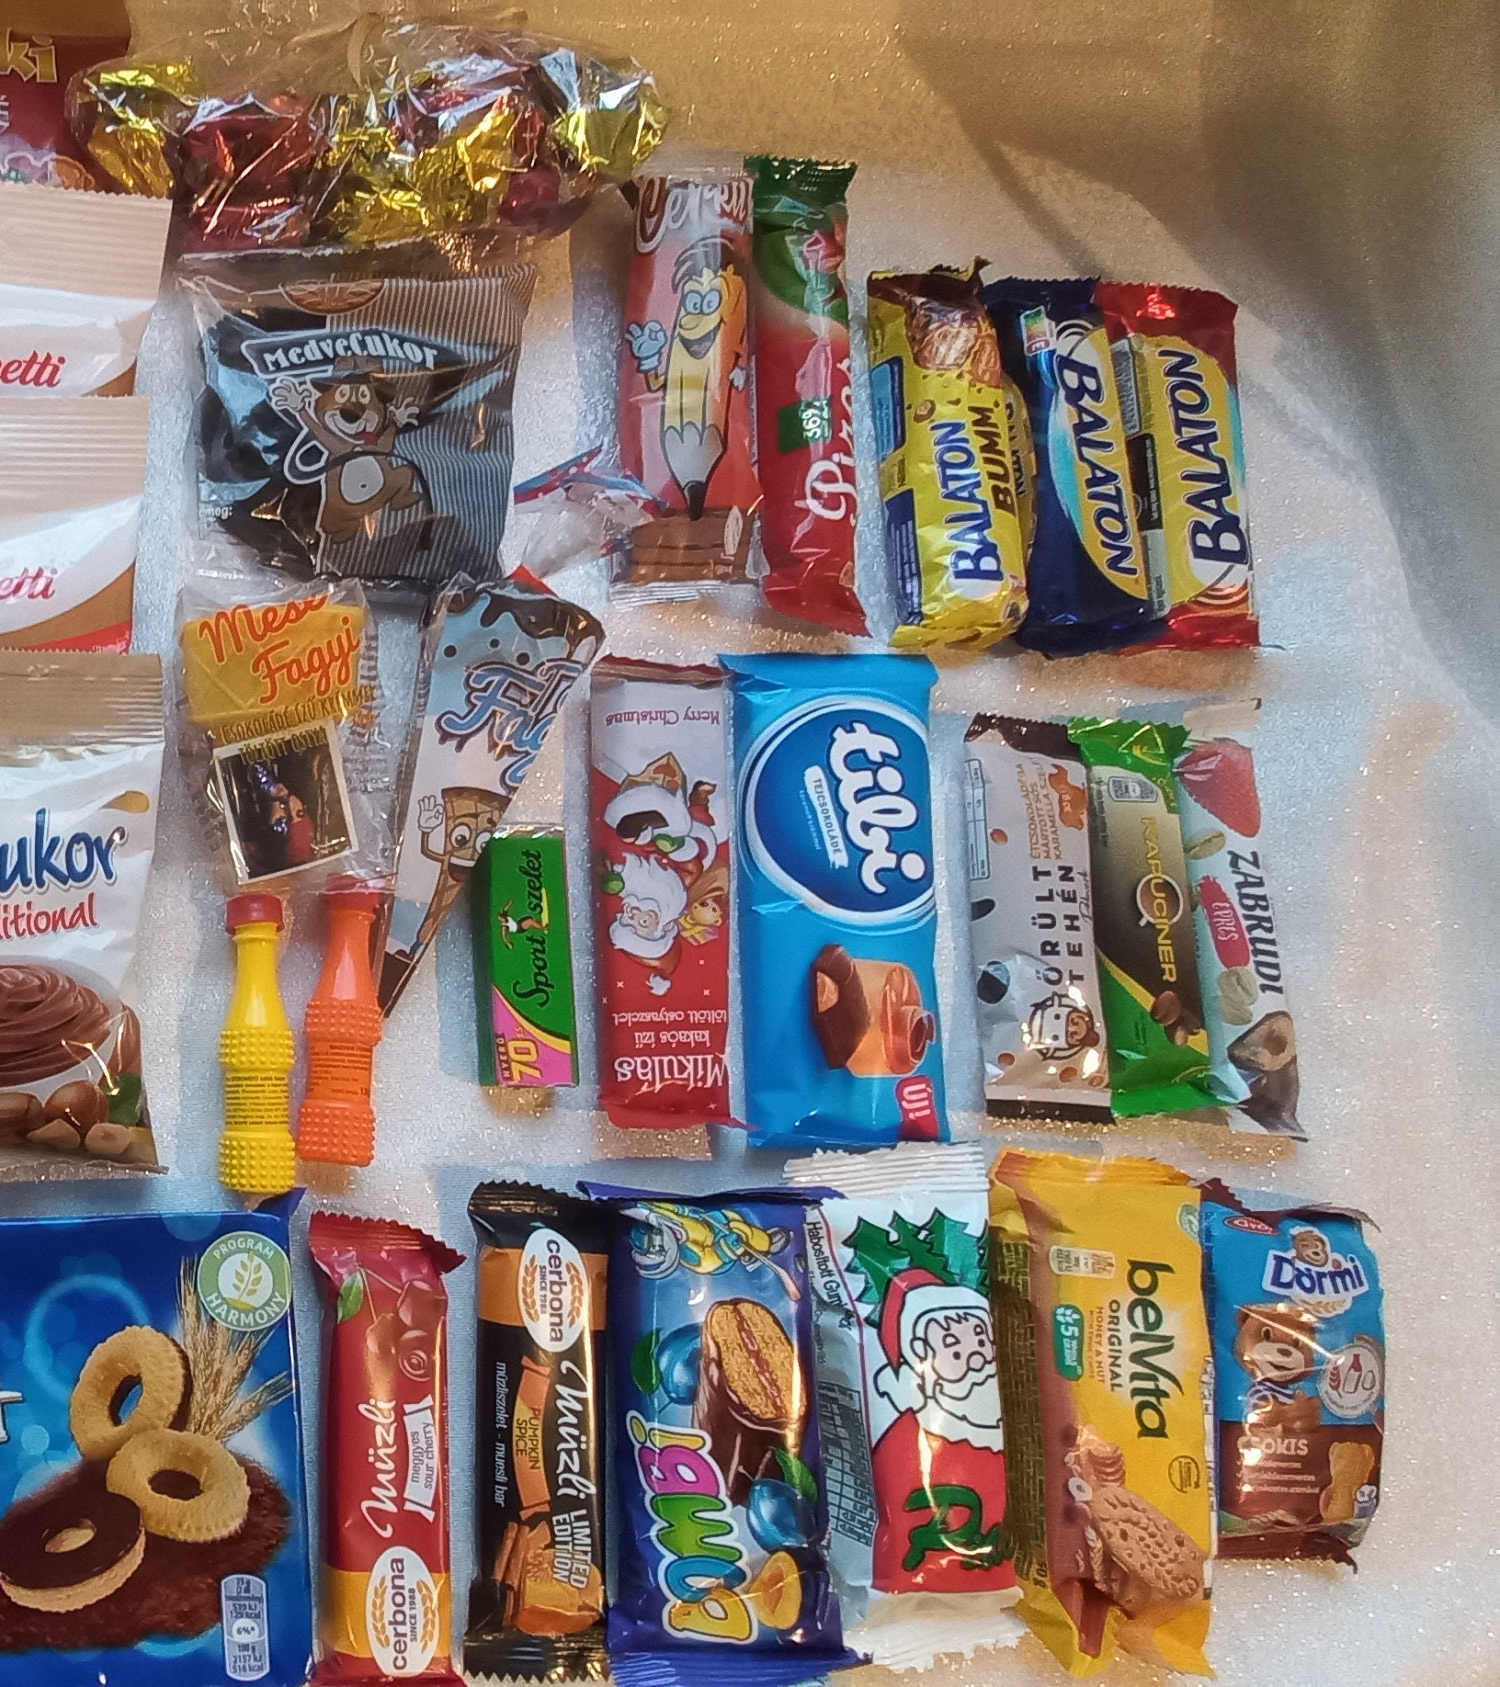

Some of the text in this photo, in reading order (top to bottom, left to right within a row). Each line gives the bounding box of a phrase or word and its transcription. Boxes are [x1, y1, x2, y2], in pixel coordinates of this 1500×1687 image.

[968, 405, 1017, 517] BUMM
[1055, 353, 1139, 577] BALATON
[1158, 348, 1250, 566] BALATON
[929, 421, 1004, 581] BALATON
[250, 616, 362, 705] Fagyi
[605, 707, 720, 726] Merry Christmas
[811, 776, 841, 857] TEJCSOKOLÁDÉ
[828, 719, 928, 897] tibi
[512, 848, 556, 1009] Sport szelet
[1056, 865, 1086, 985] TEHÉN
[1140, 815, 1178, 983] KAPUCINER
[1211, 900, 1240, 943] EPRES
[1227, 850, 1284, 995] ZABRUDI
[508, 1038, 543, 1085] 70
[614, 1053, 727, 1093] Mikulás
[634, 1030, 710, 1047] kakaós ízű
[212, 1237, 275, 1260] PROGRAM
[538, 1265, 547, 1291] SINCE
[1270, 1253, 1365, 1295] Dörmi
[205, 1291, 286, 1327] HARMONY
[546, 1238, 565, 1344] cerbona
[1061, 1325, 1079, 1337] 5
[1107, 1299, 1123, 1392] ORIGINAL
[1127, 1258, 1185, 1440] belVita
[361, 1397, 398, 1539] Müzli
[409, 1430, 421, 1485] meggyes
[422, 1421, 436, 1489] sour cherry
[495, 1442, 506, 1481] muesli
[515, 1418, 527, 1457] SPICE
[529, 1406, 541, 1471] PUMPKIN
[550, 1359, 597, 1590] Müzli LIMITED EDITION
[493, 1483, 504, 1507] bar
[391, 1557, 408, 1673] cerbona
[408, 1613, 418, 1643] SINCE
